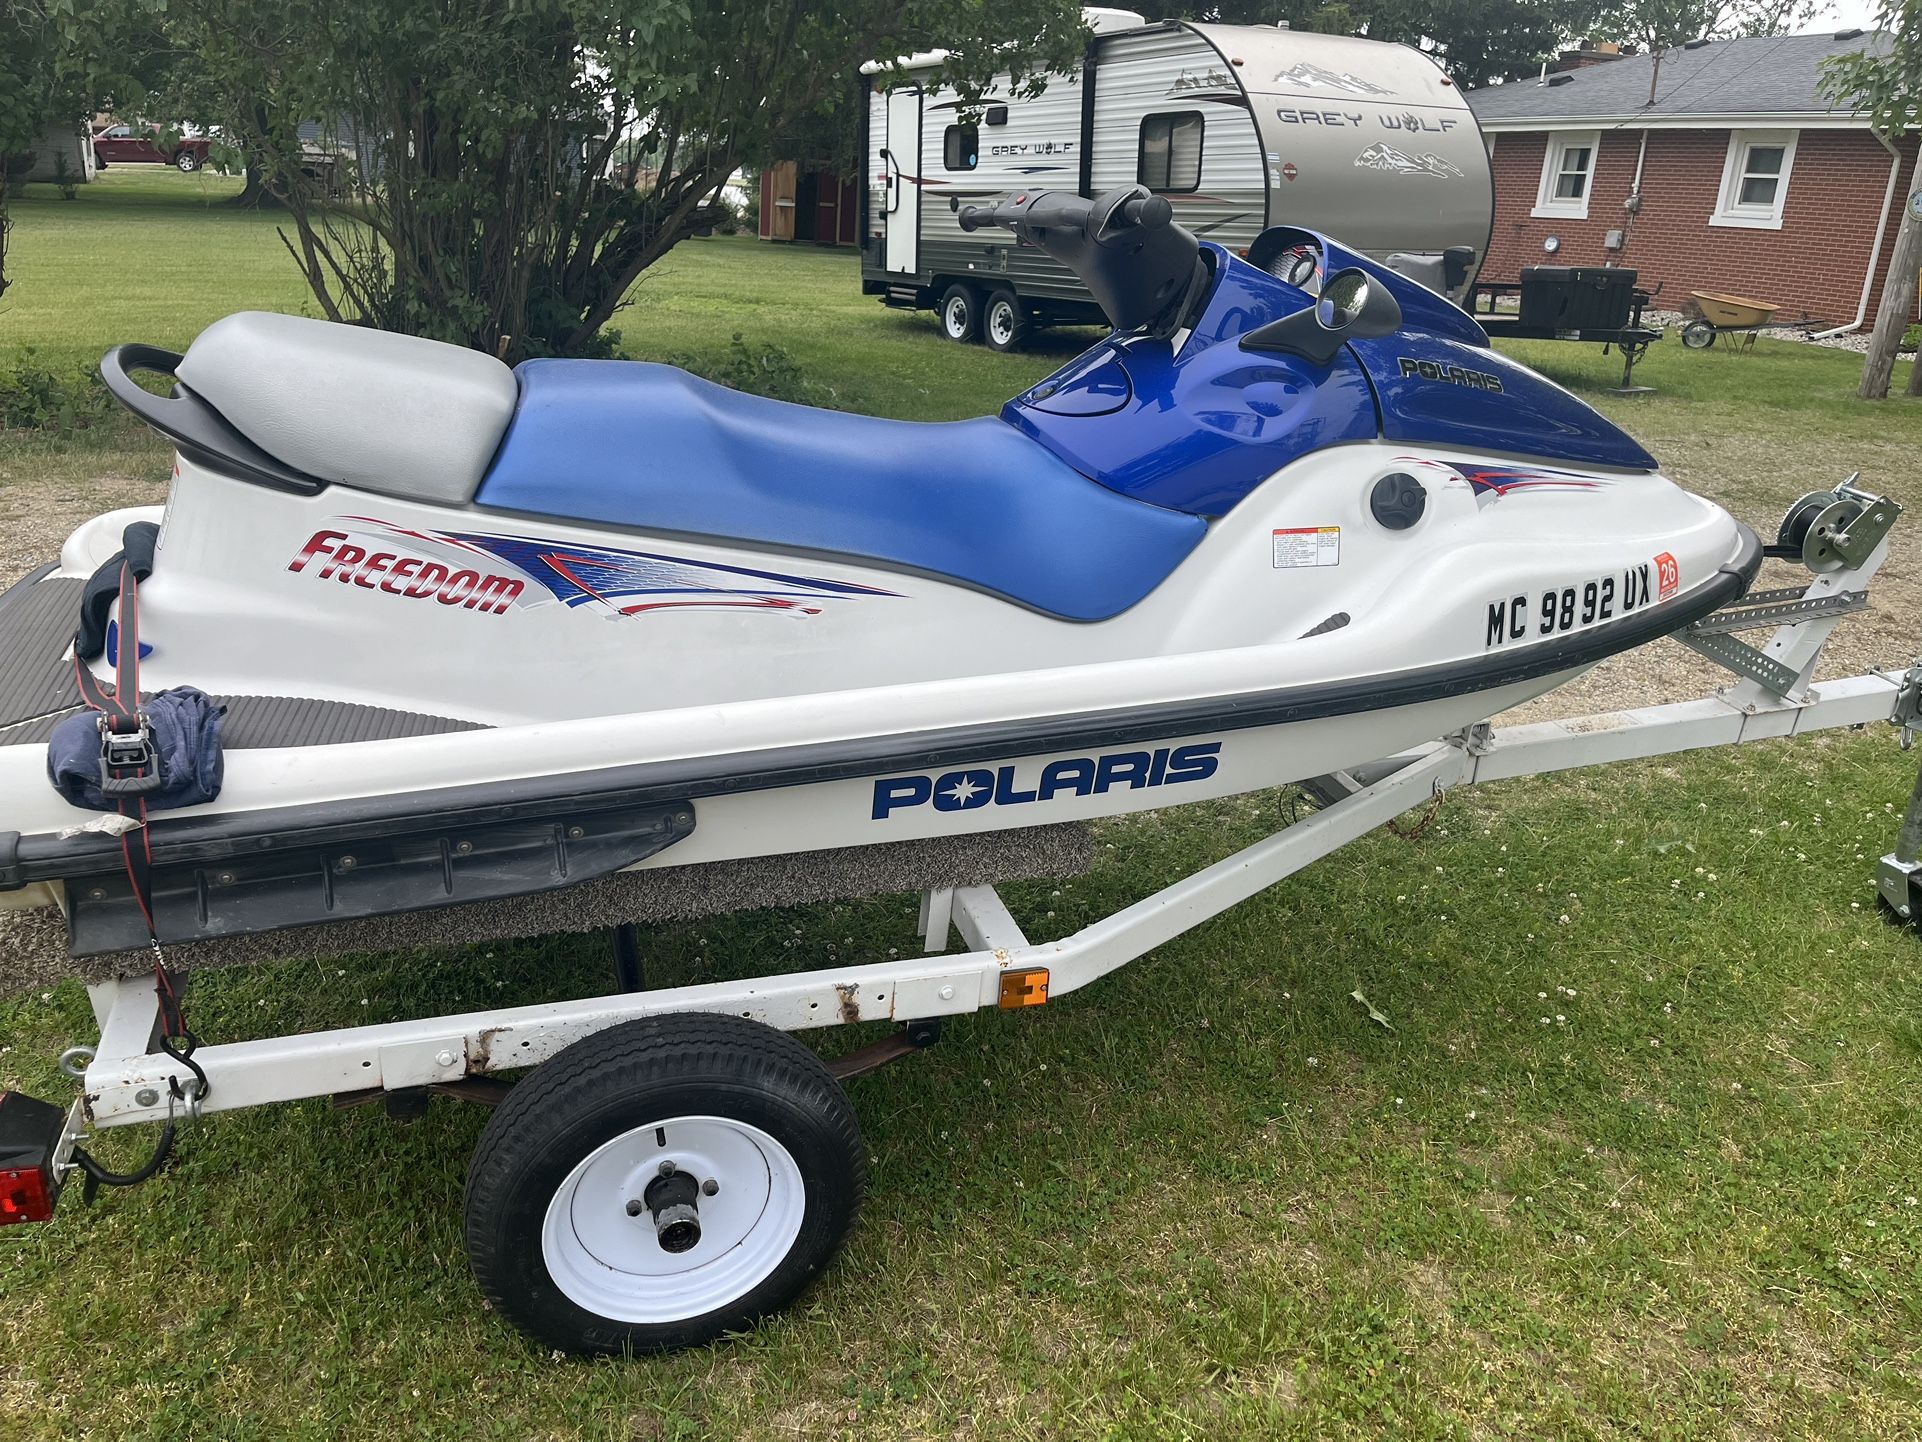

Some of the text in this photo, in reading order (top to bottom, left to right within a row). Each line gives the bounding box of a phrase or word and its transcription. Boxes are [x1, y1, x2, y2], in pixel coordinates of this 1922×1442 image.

[1276, 108, 1362, 127] GREY
[992, 145, 1027, 155] GREY
[1397, 357, 1504, 394] POLARIS
[285, 530, 526, 616] FREEDOM
[1661, 559, 1676, 588] 26
[1487, 564, 1650, 646] MC 9892 UX
[871, 741, 1222, 820] POLARIS
